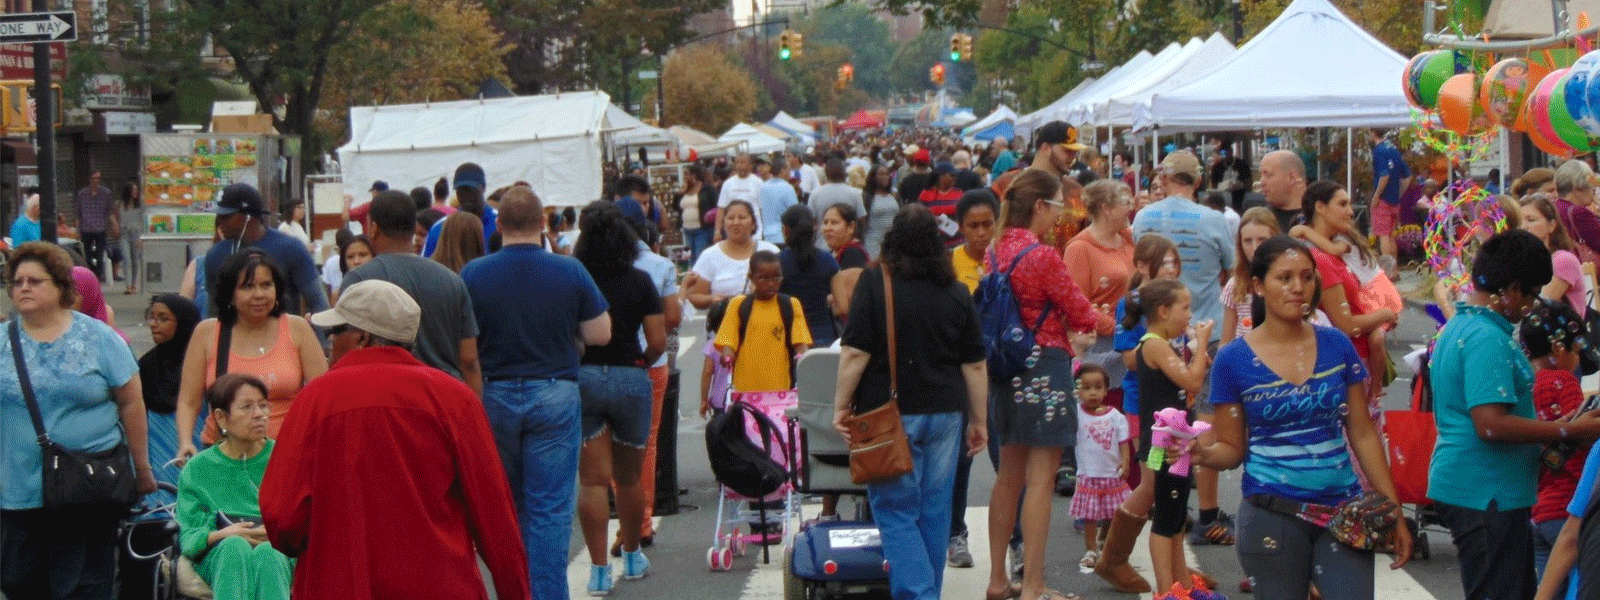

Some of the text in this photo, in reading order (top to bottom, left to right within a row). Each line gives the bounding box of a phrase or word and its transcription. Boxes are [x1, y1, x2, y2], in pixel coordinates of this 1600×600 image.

[0, 22, 62, 35] ONE WAY
[1242, 384, 1314, 402] merican
[1262, 382, 1342, 424] eagle
